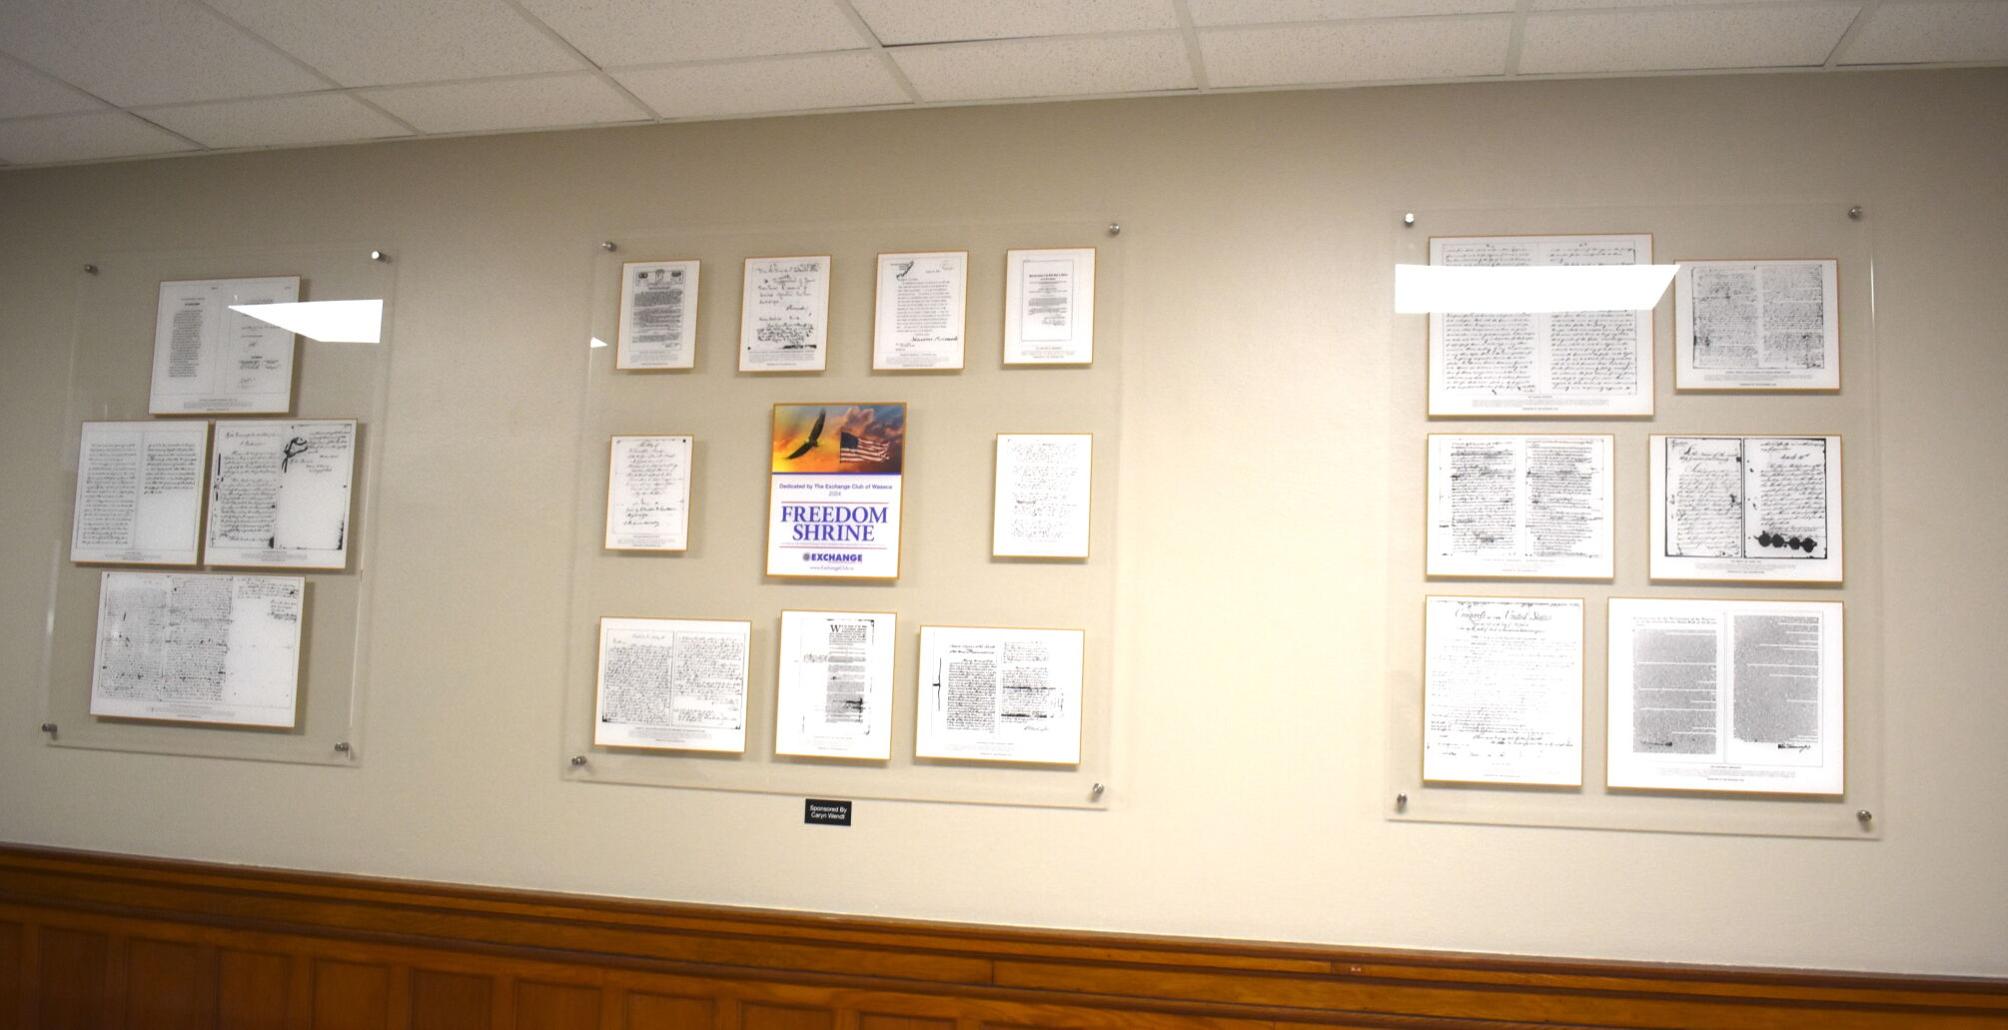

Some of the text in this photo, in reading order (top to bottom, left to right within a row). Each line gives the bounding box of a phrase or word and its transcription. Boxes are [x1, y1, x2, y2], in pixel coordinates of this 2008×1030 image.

[807, 483, 813, 491] by
[825, 483, 850, 491] Exchange
[781, 506, 888, 523] FREEDOM
[792, 524, 875, 541] SHRINE
[811, 553, 863, 562] EXCHANGE
[810, 804, 848, 814] Sponsored By
[810, 811, 827, 820] Caryn
